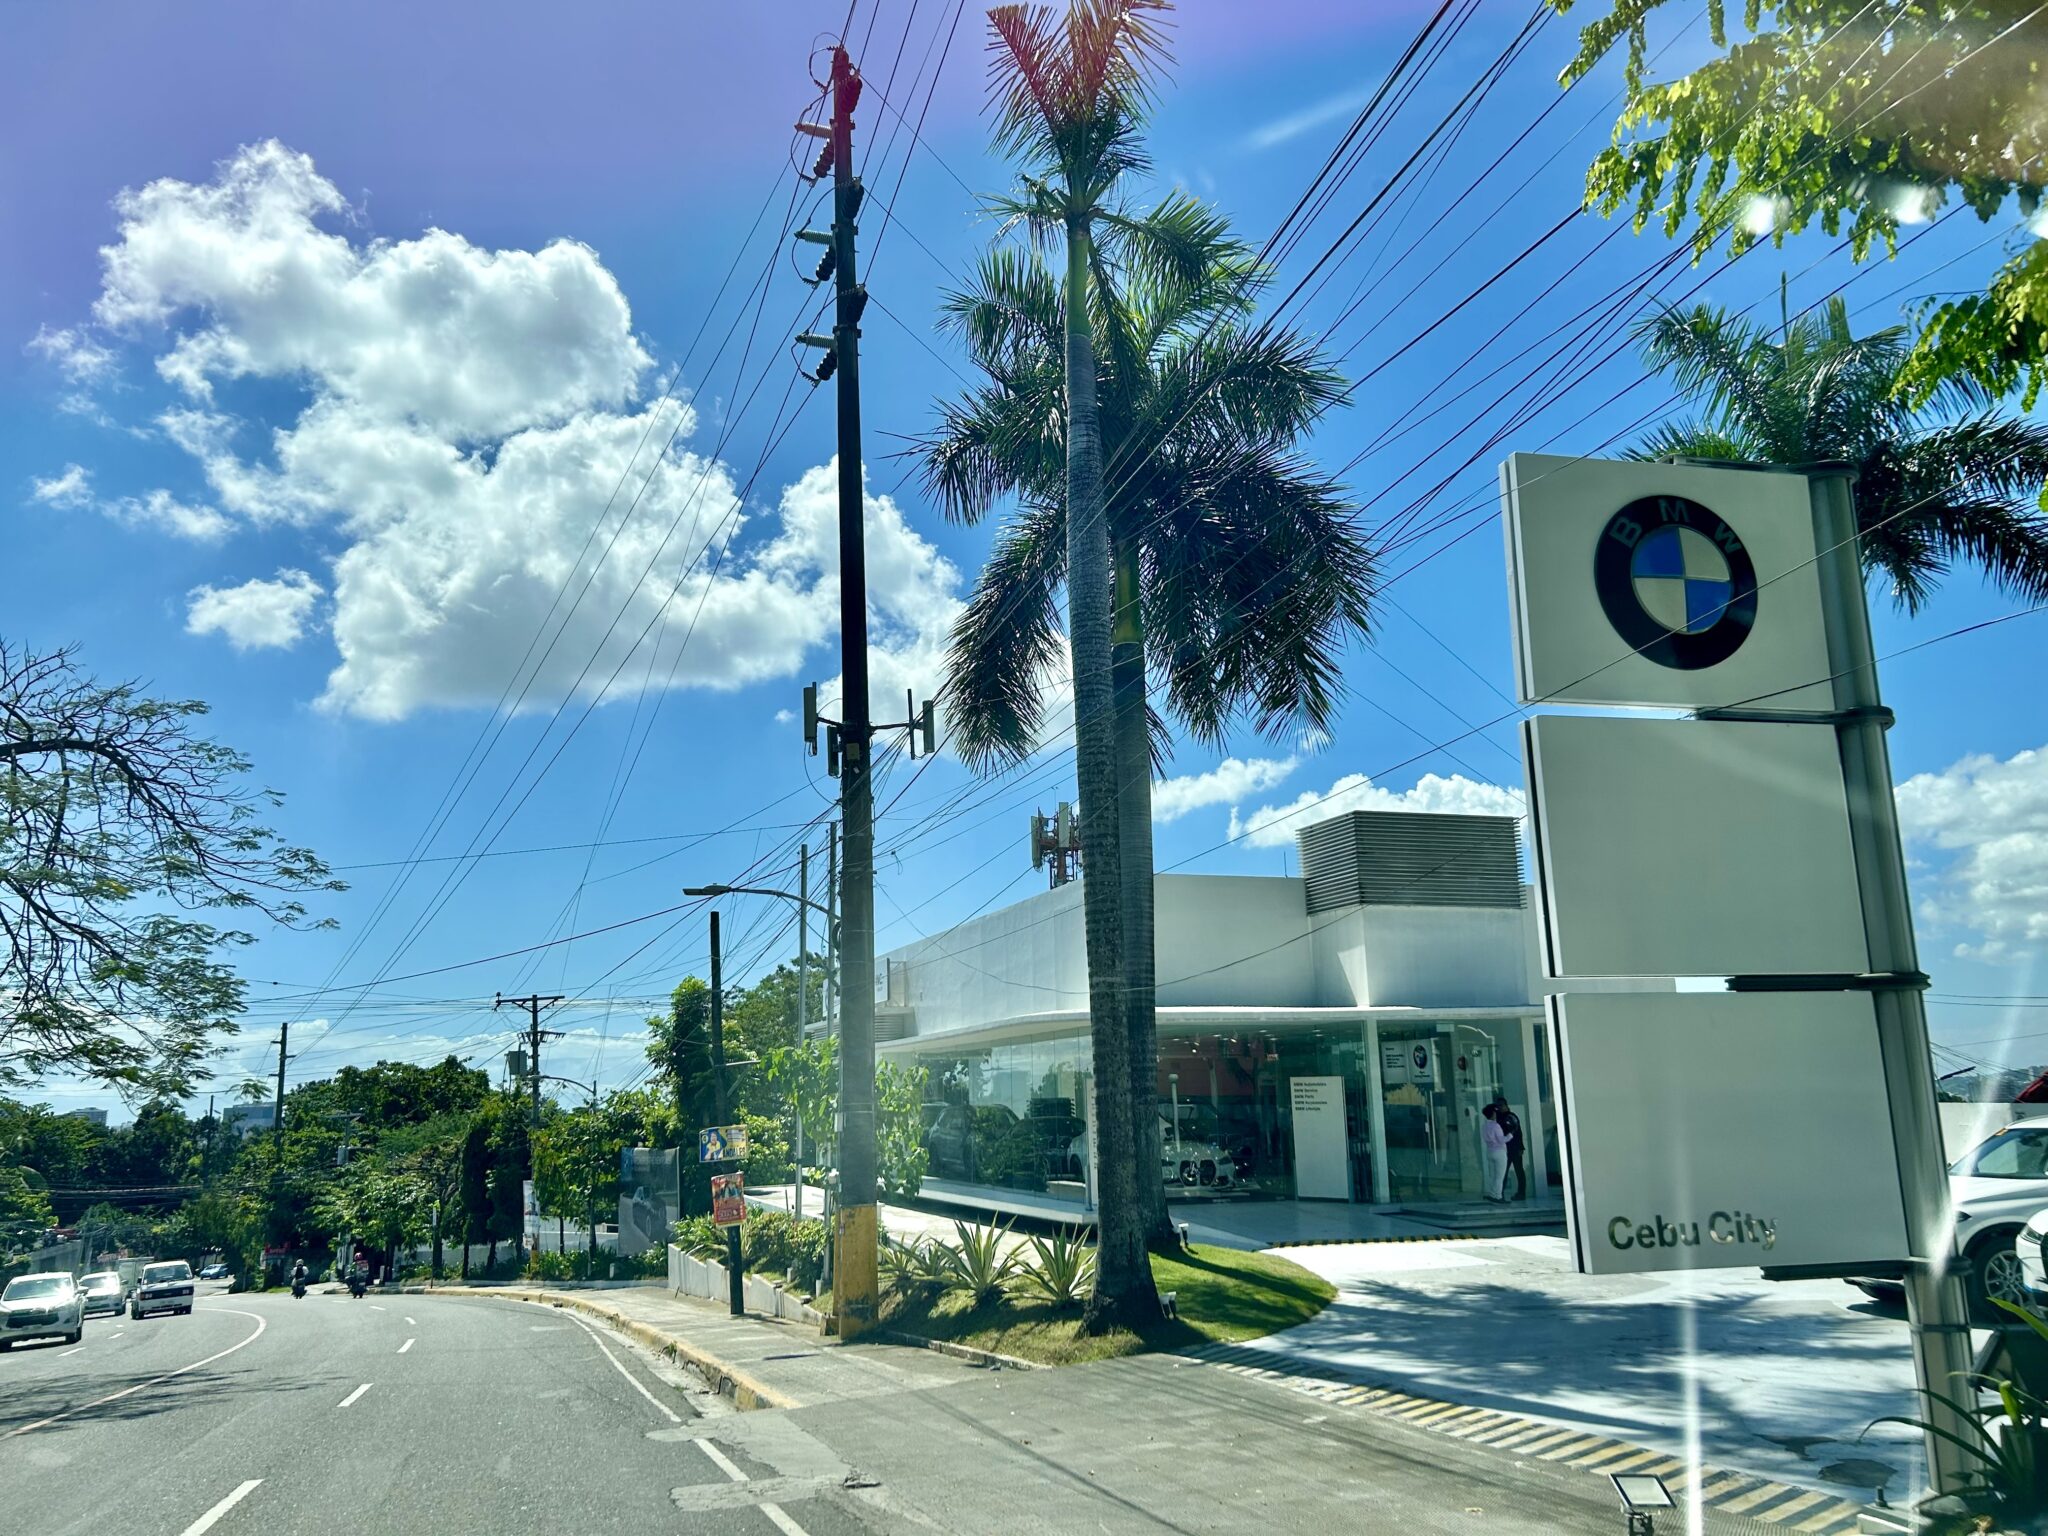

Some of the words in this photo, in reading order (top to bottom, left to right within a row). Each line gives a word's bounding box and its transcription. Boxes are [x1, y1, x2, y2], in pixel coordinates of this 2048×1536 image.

[1608, 498, 1743, 554] BMW
[1608, 1215, 1700, 1249] Cebu
[1708, 1211, 1779, 1250] City
